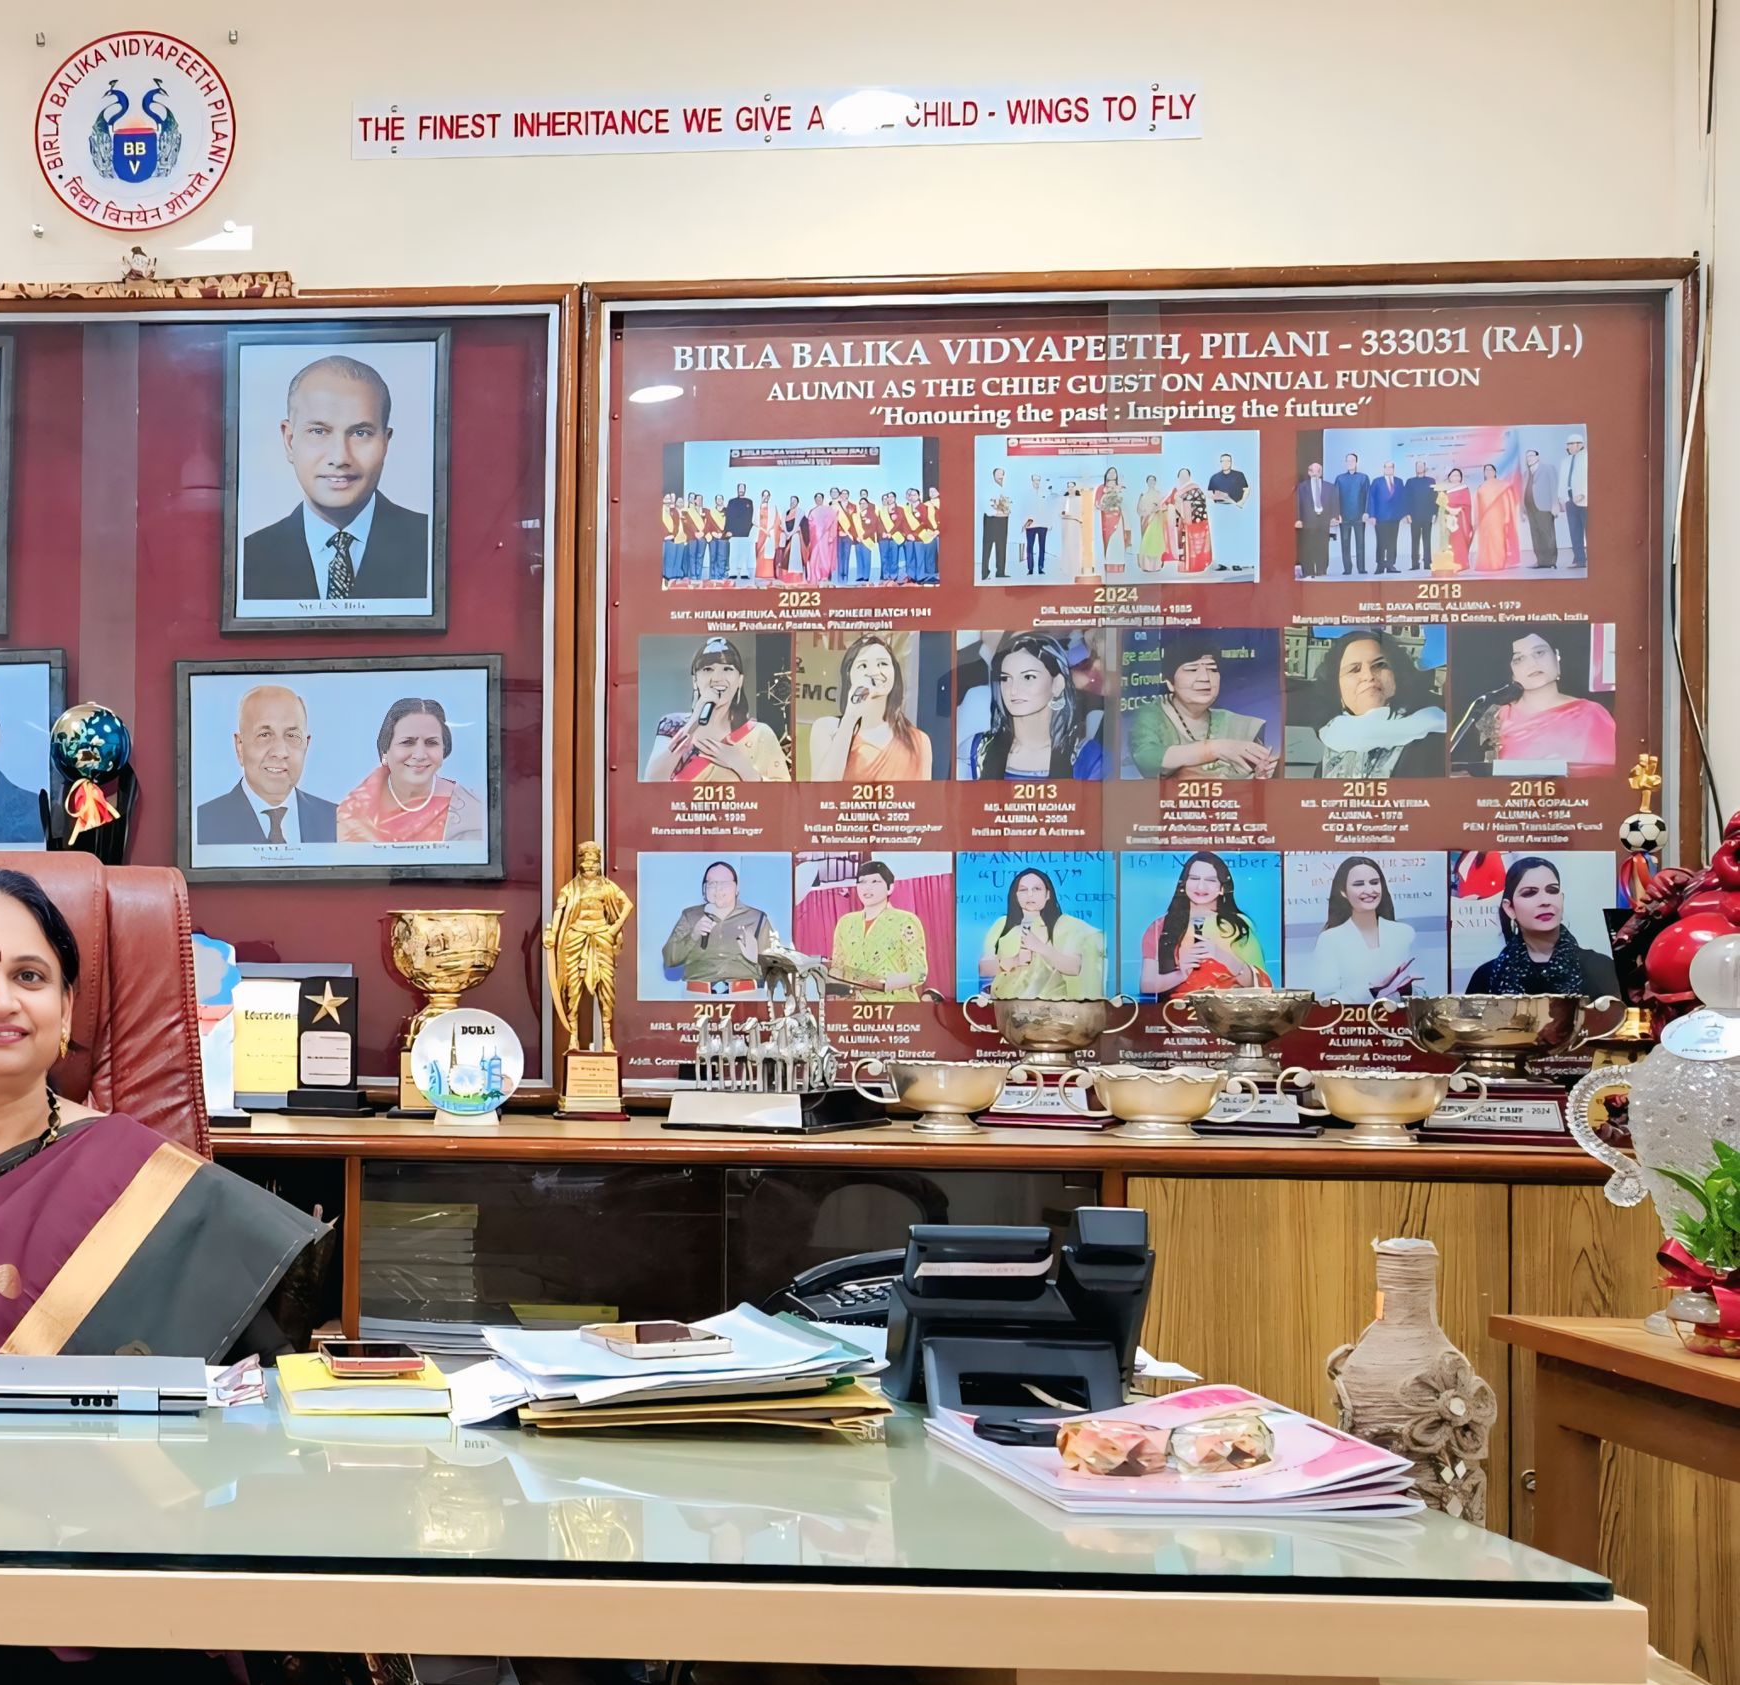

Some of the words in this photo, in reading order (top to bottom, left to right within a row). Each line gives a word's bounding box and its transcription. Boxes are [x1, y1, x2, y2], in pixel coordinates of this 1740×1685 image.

[108, 38, 219, 97] VIDYAPEETH
[50, 49, 107, 108] BALIKA
[358, 116, 405, 142] THE
[418, 113, 501, 140] FINEST
[514, 108, 670, 138] INHERITANCE
[683, 107, 722, 133] WE
[735, 105, 792, 131] GIVE
[807, 105, 825, 130] A
[906, 100, 979, 128] CHILD
[1006, 96, 1089, 125] WINGS
[1102, 94, 1137, 122] TO
[1152, 93, 1197, 121] FLY
[208, 98, 229, 164] PILANI
[43, 113, 64, 170] BIRLA
[123, 141, 146, 156] BB
[129, 160, 141, 176] V
[673, 343, 782, 372] BIRLA
[791, 339, 931, 369] BALIKA
[939, 331, 1190, 367] VIDYAPEETH,
[1199, 330, 1330, 361] PILANI
[1360, 327, 1471, 356] 333031
[1482, 324, 1584, 360] (RAJ.)
[766, 379, 876, 401] ALUMNI
[883, 378, 916, 399] AS
[922, 377, 975, 398] THE
[981, 376, 1060, 397] CHIEF
[1066, 373, 1156, 395] GUEST
[1161, 372, 1203, 392] ON
[1209, 369, 1329, 392] ANNUAL
[1335, 367, 1481, 389] FUNCTION
[1016, 402, 1053, 423] the
[1059, 402, 1107, 431] past
[1127, 399, 1236, 424] Inspiring
[1241, 398, 1279, 419] the
[1094, 587, 1138, 602] 2024
[1417, 584, 1462, 599] 2018
[778, 592, 821, 607] 2023
[779, 609, 821, 619] ALUMNA
[874, 608, 908, 617] BATCH
[693, 786, 735, 801] 2013
[852, 785, 895, 800] 2013
[1014, 784, 1058, 799] 2013
[1178, 783, 1223, 797] 2015
[1343, 782, 1388, 797] 2015
[1510, 782, 1555, 797] 2016
[694, 1004, 736, 1019] 2017
[852, 1005, 895, 1020] 2017
[461, 1025, 495, 1036] DUBAI
